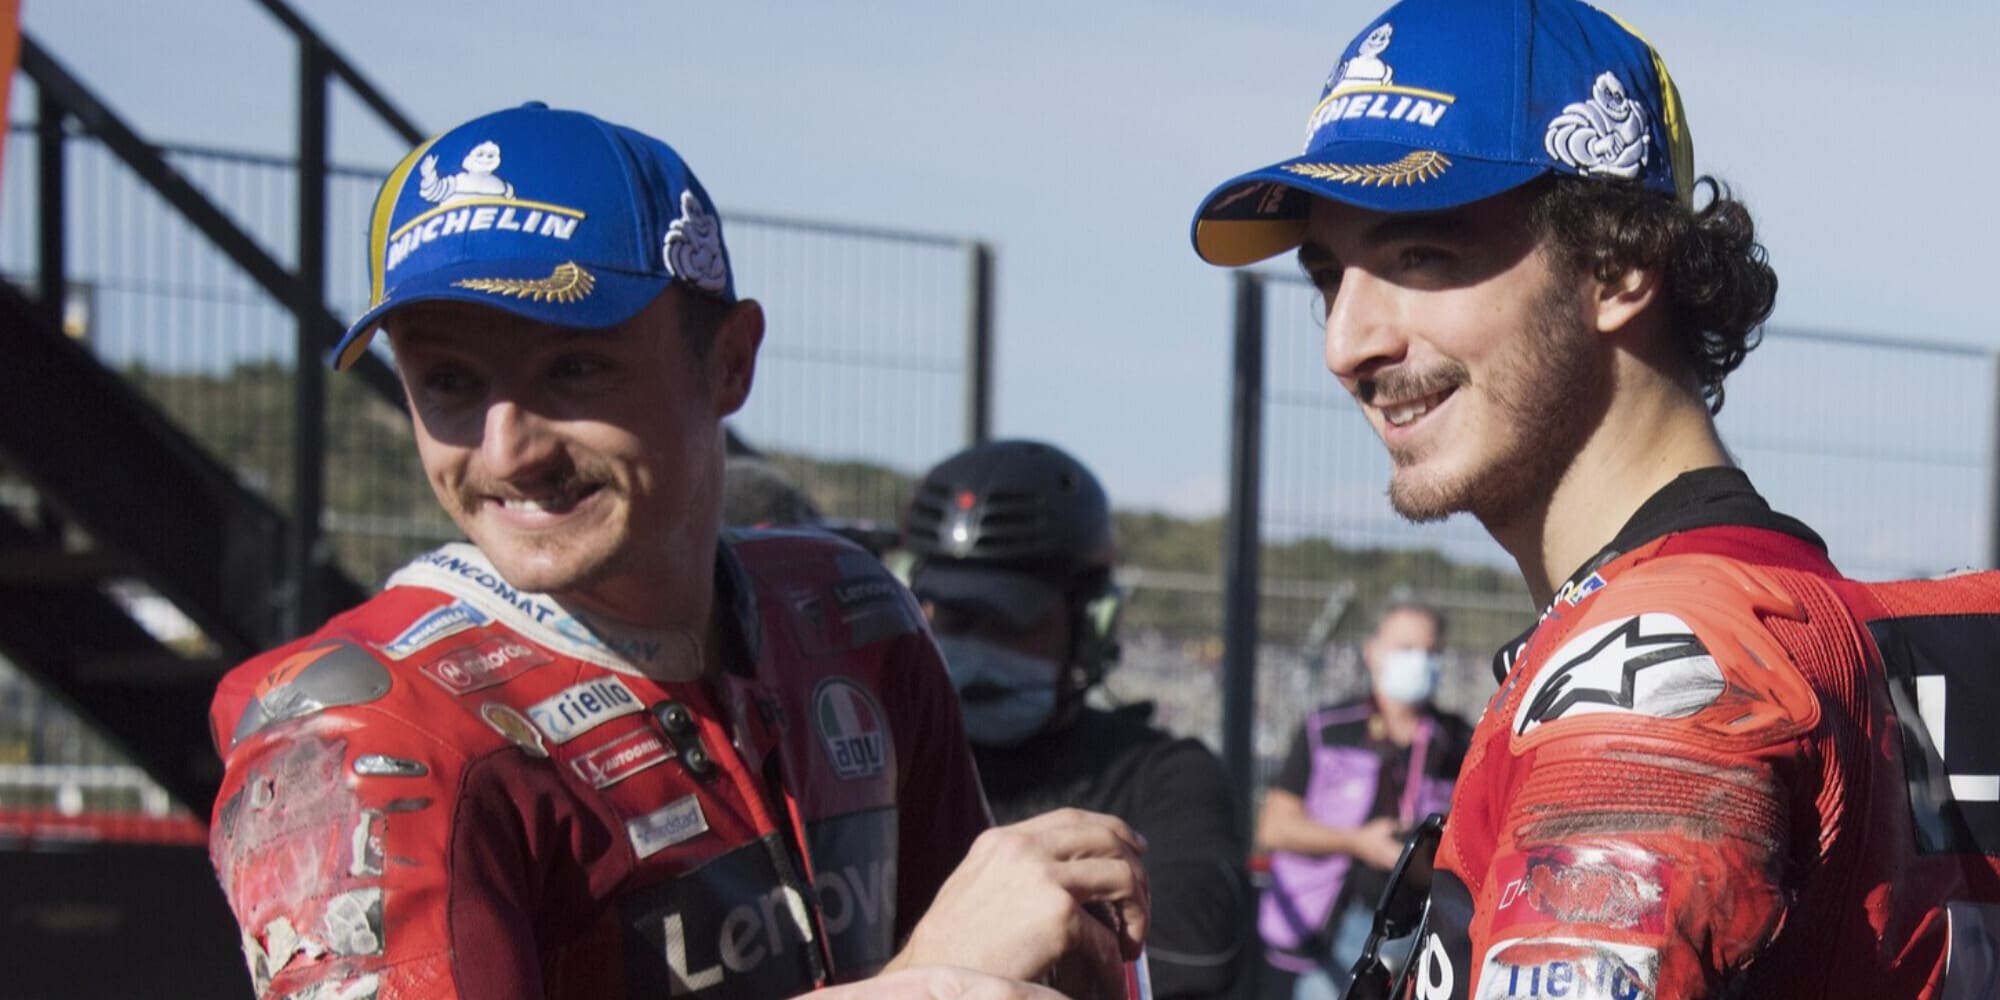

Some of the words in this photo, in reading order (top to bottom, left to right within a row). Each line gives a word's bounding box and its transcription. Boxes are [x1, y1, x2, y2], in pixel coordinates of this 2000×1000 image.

[386, 206, 579, 271] MICHELIN
[558, 675, 633, 726] riello
[835, 735, 880, 774] agv
